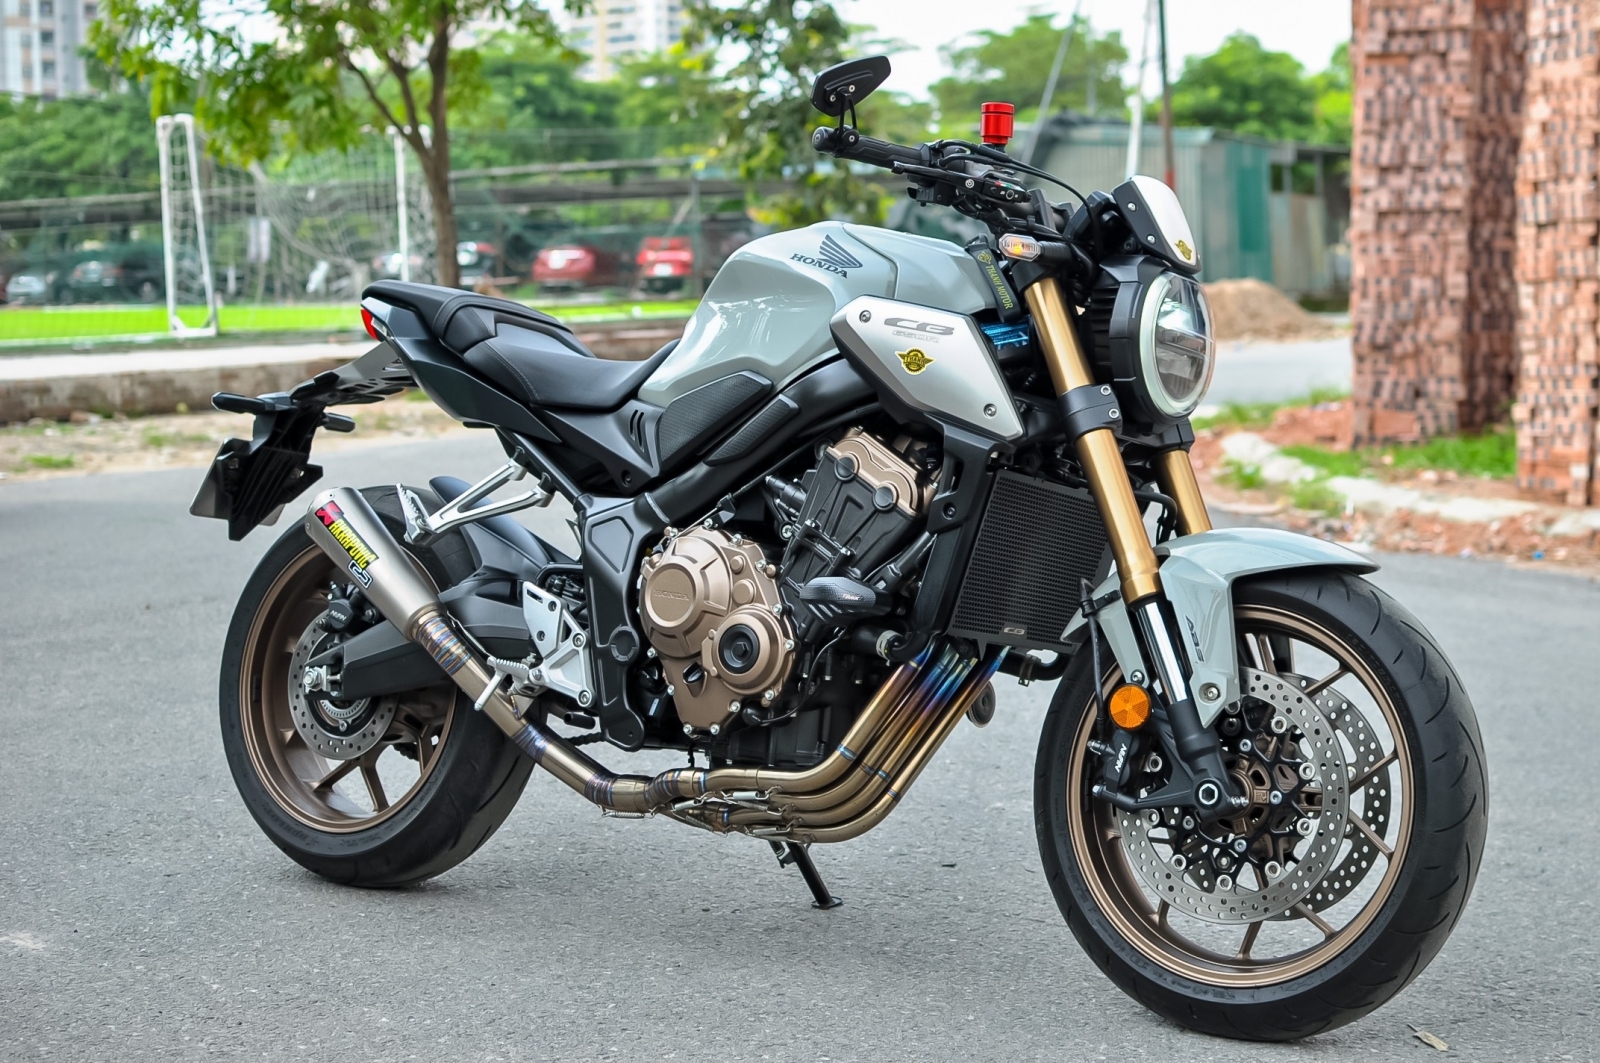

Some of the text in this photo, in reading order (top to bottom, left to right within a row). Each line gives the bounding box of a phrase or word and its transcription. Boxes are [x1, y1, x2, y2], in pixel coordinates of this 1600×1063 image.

[790, 253, 848, 279] HONDA
[985, 264, 1003, 287] THANH
[997, 284, 1014, 310] MOTOR
[884, 317, 955, 336] CB
[653, 589, 690, 601] HONDA
[1184, 614, 1205, 663] ABS
